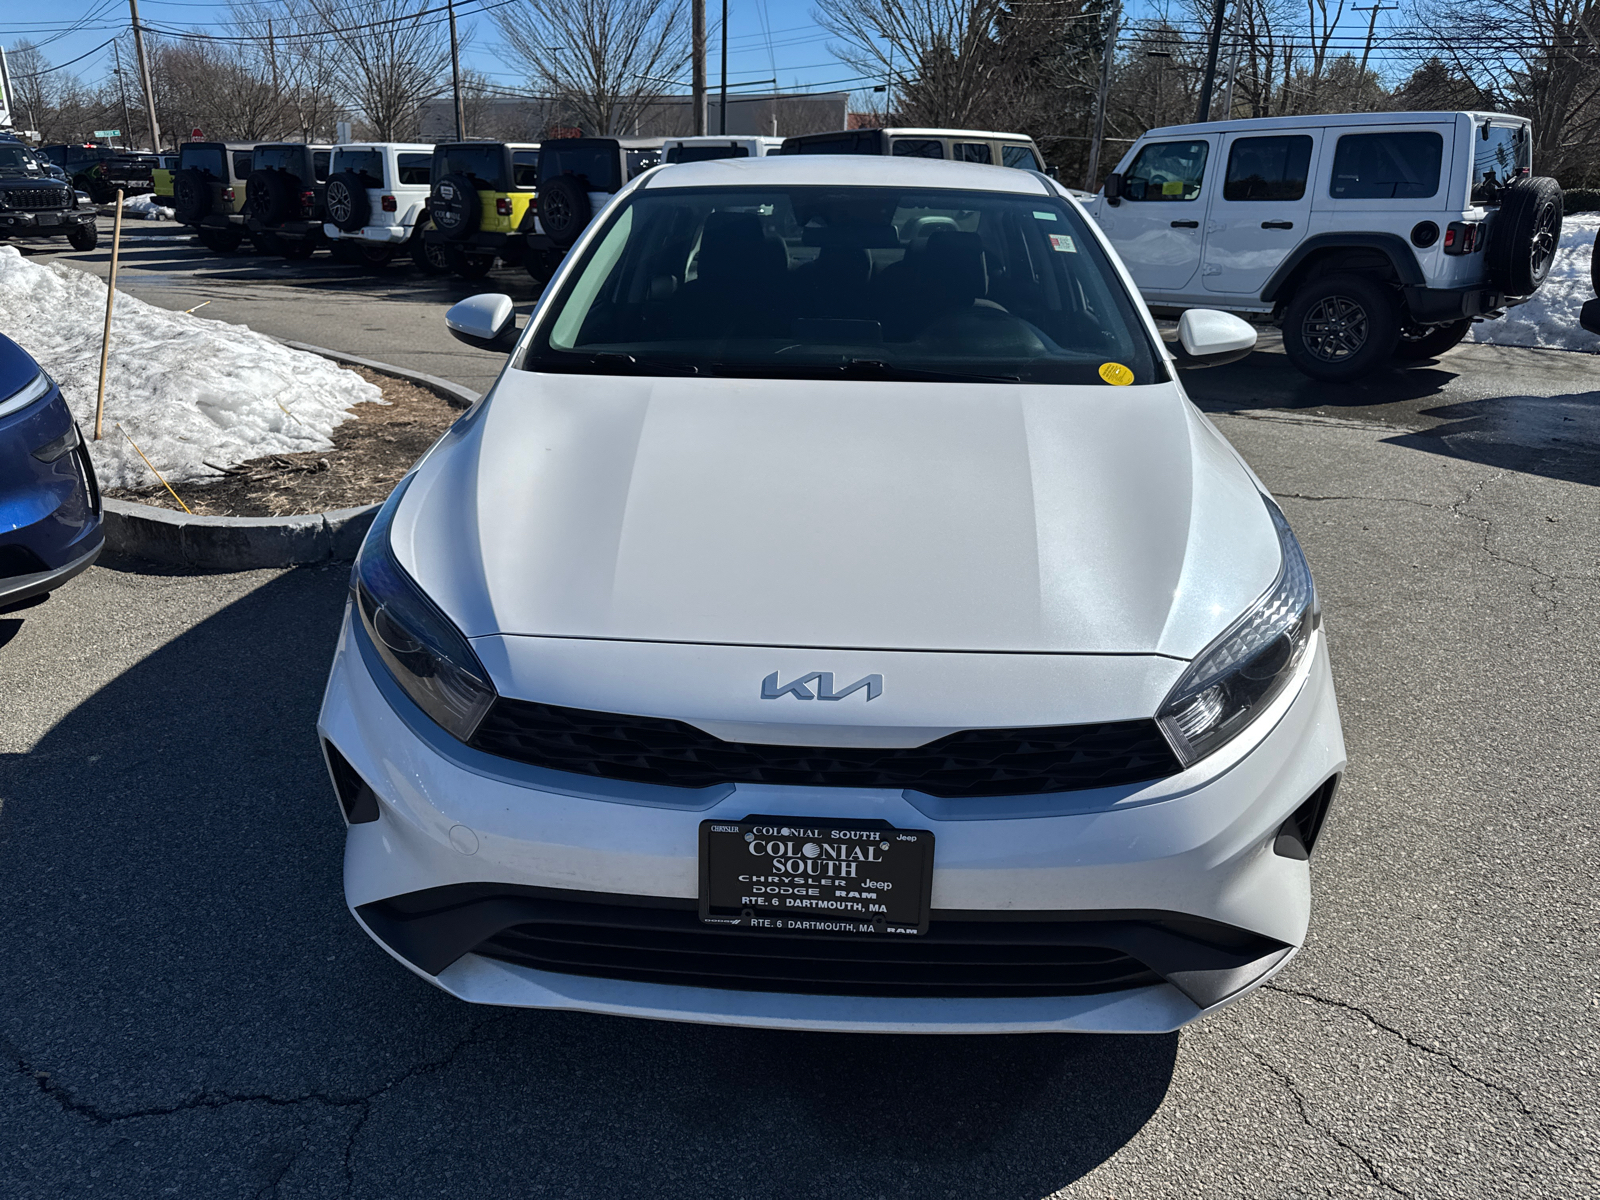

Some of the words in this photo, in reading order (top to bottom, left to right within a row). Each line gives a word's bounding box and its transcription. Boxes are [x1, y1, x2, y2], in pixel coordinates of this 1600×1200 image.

[760, 670, 883, 702] KIA
[710, 825, 740, 833] CHRYSLER
[752, 826, 823, 839] COLONIAL
[830, 829, 881, 841] SOUTH
[896, 833, 918, 843] Jeep
[748, 840, 883, 862] COLONIAL
[772, 858, 858, 878] SOUTH
[738, 875, 847, 887] CHRYSLER
[861, 879, 893, 891] Jeep
[752, 885, 820, 896] DODGE
[834, 890, 877, 900] RAM
[741, 896, 769, 906] RTE.
[771, 897, 780, 906] 6
[785, 898, 865, 912] DARTMOUTH,
[868, 903, 888, 913] MA
[750, 918, 774, 928] RTE.
[776, 920, 783, 928] 6
[787, 920, 857, 933] DARTMOUTH,
[859, 924, 875, 933] MA
[886, 927, 918, 935] RAM
